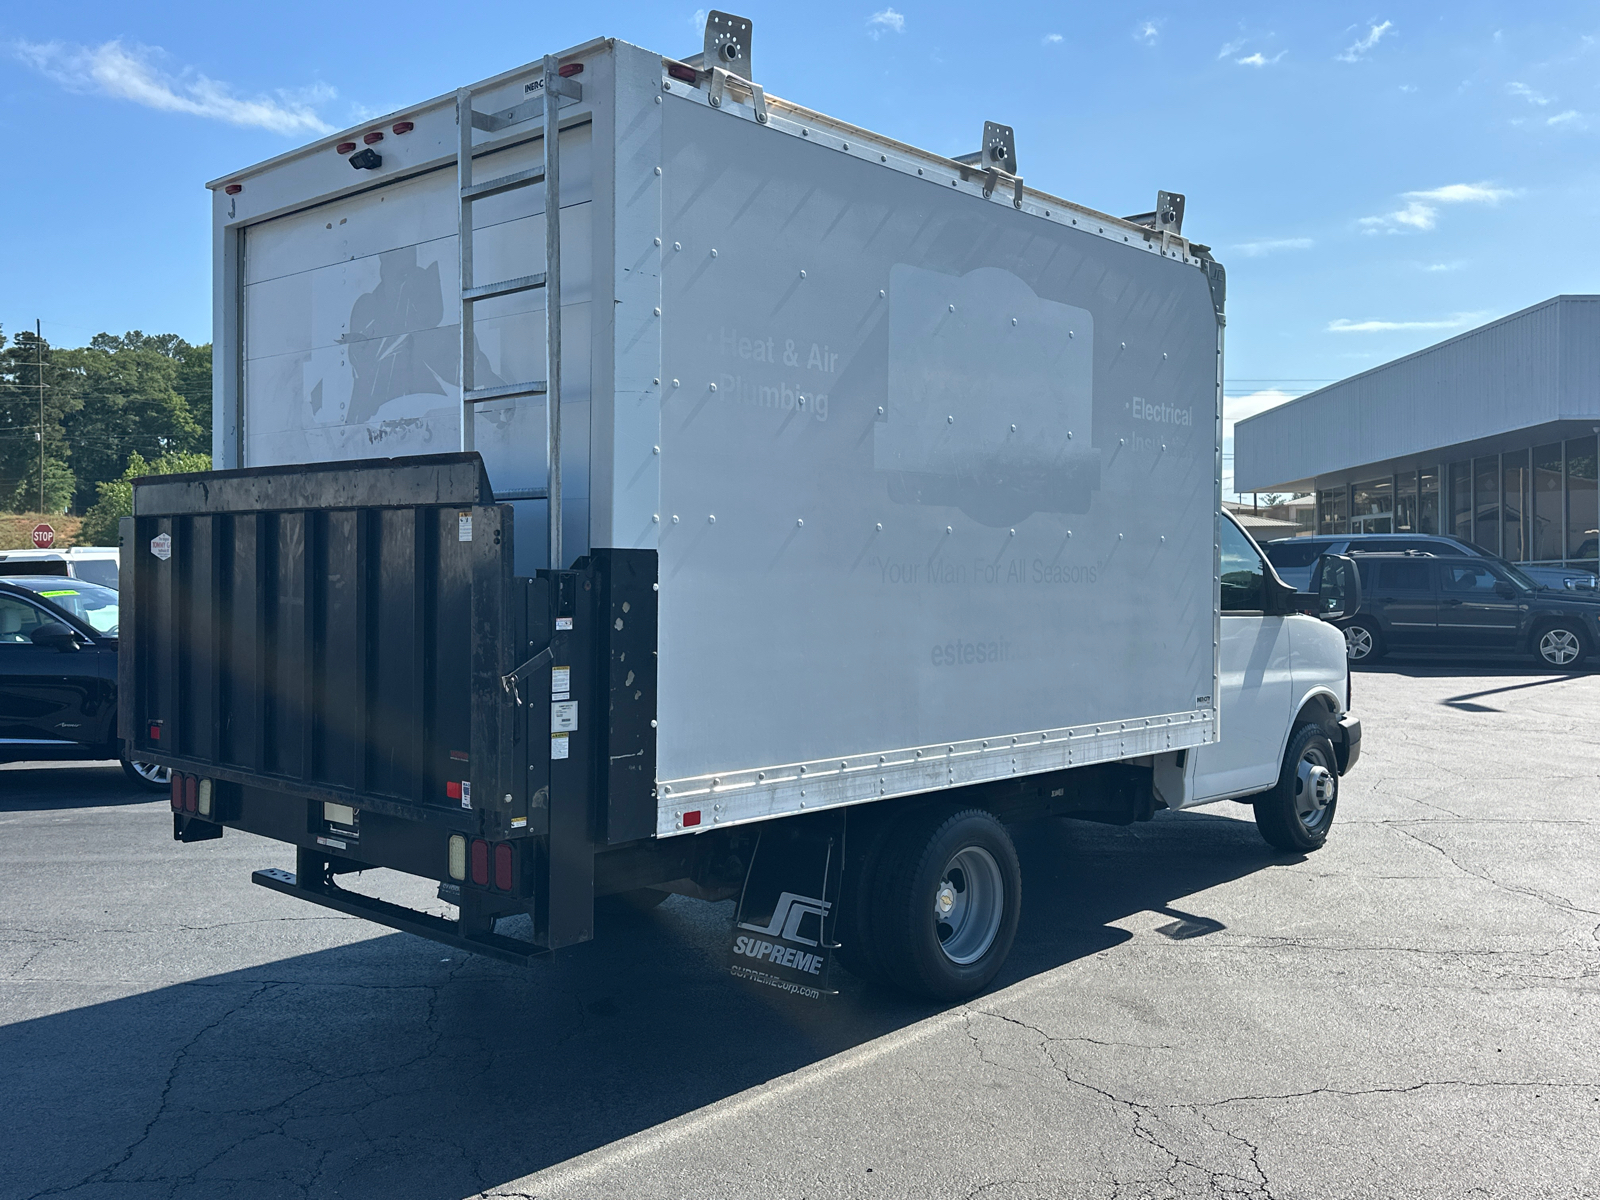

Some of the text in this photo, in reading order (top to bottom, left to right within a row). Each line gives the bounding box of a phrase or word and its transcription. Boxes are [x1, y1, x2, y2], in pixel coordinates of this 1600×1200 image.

[524, 79, 544, 93] INER-C
[719, 325, 839, 373] Heat & Air
[719, 372, 829, 422] Plumbing
[1132, 396, 1193, 427] Electrical
[33, 531, 53, 542] STOP
[927, 556, 967, 584] Man
[973, 556, 1002, 584] For
[1006, 558, 1026, 584] All
[732, 935, 824, 975] SUPREME
